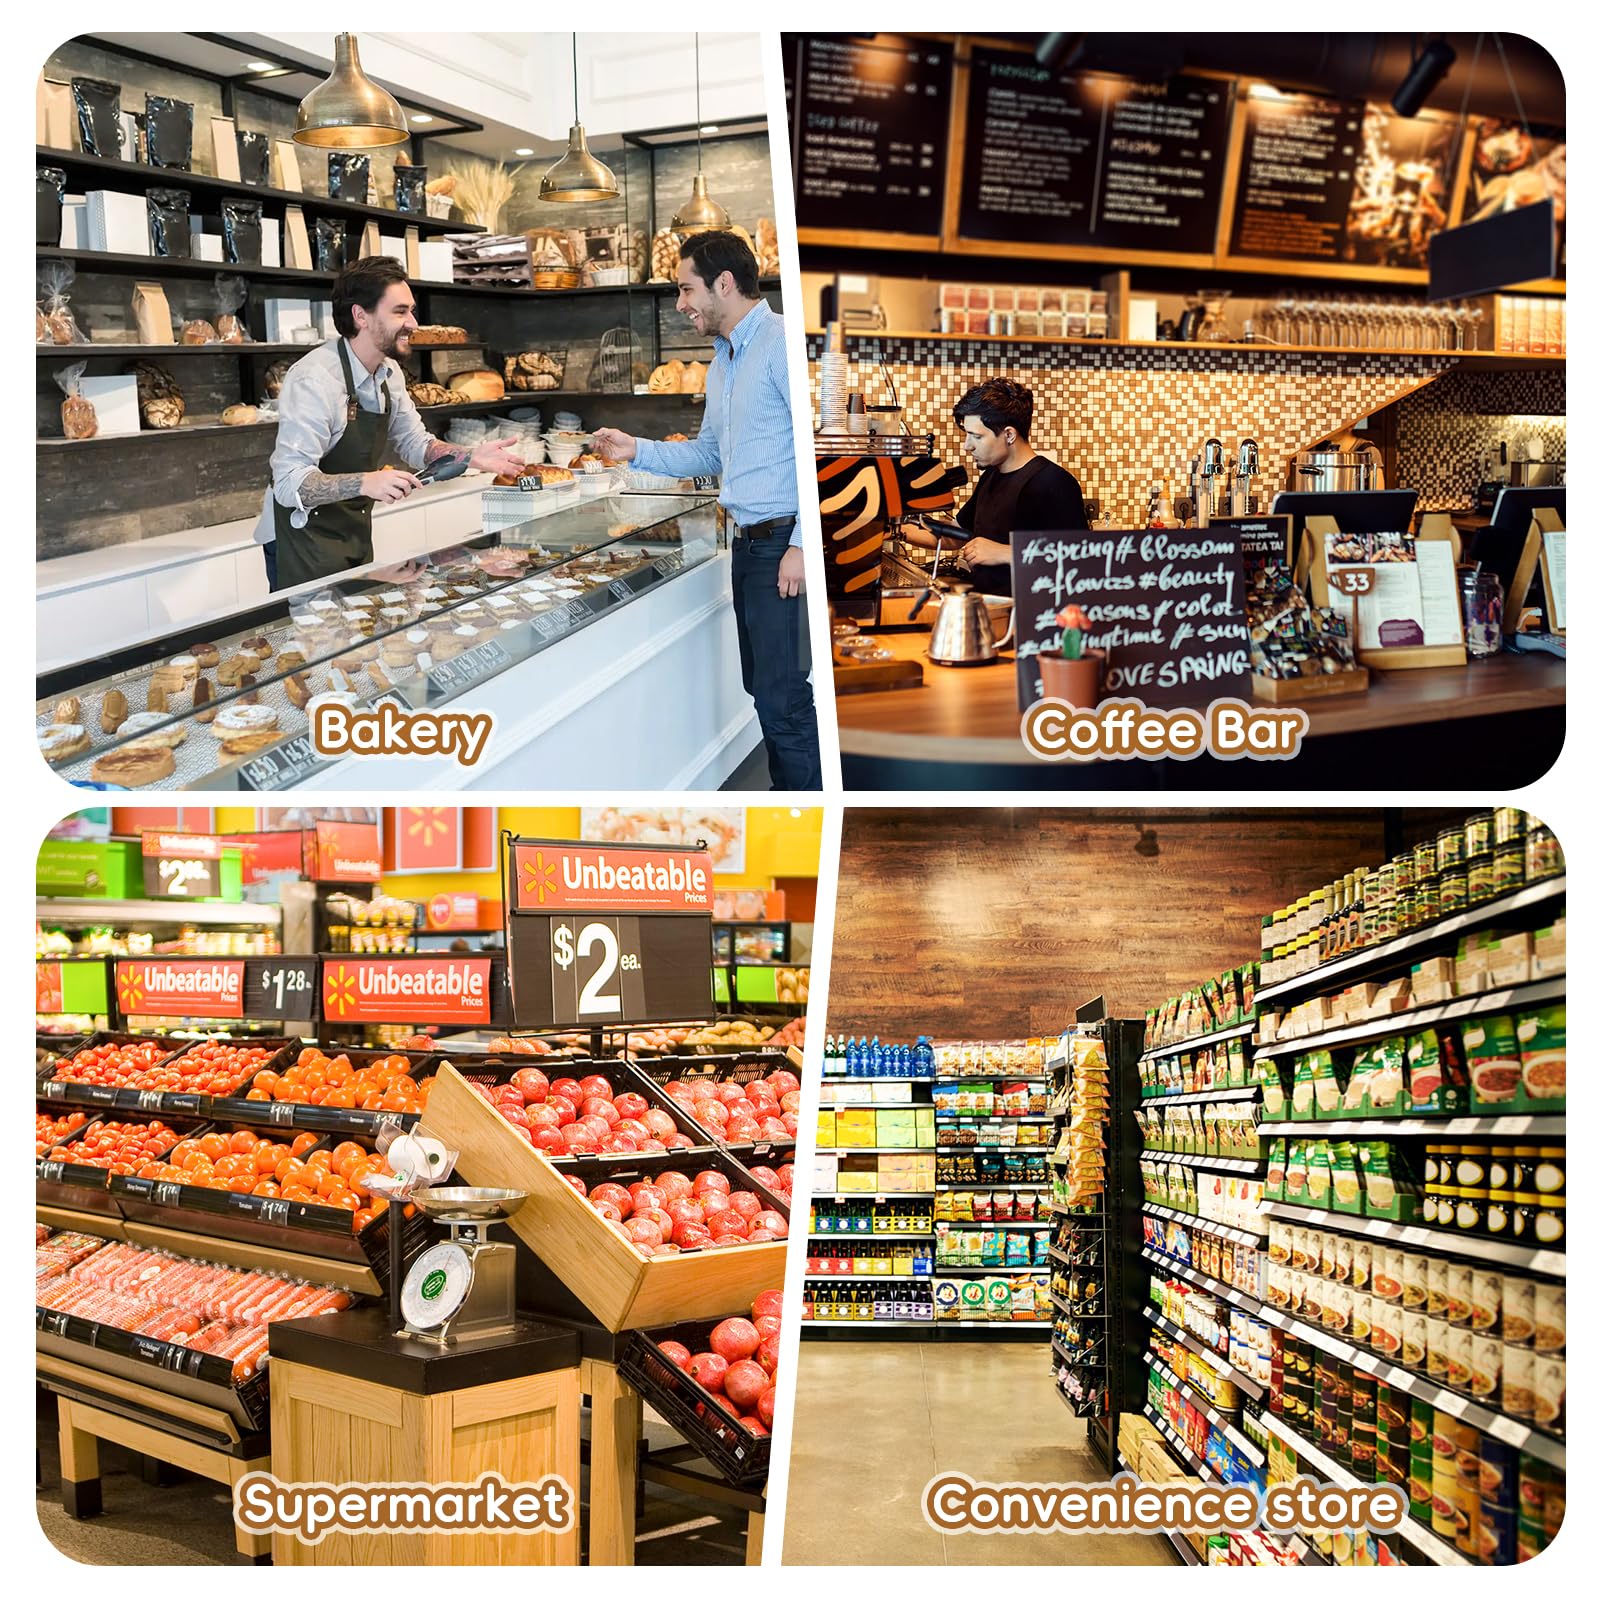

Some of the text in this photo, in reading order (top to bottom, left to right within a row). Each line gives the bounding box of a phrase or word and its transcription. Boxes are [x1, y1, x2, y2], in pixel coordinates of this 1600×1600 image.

[1345, 573, 1370, 592] 33
[562, 855, 706, 891] Unbeatable
[684, 892, 707, 904] Prices
[144, 966, 239, 993] Unbeatable
[358, 964, 482, 995] Unbeatable
[220, 992, 238, 1003] Prices
[460, 995, 483, 1006] Prices
